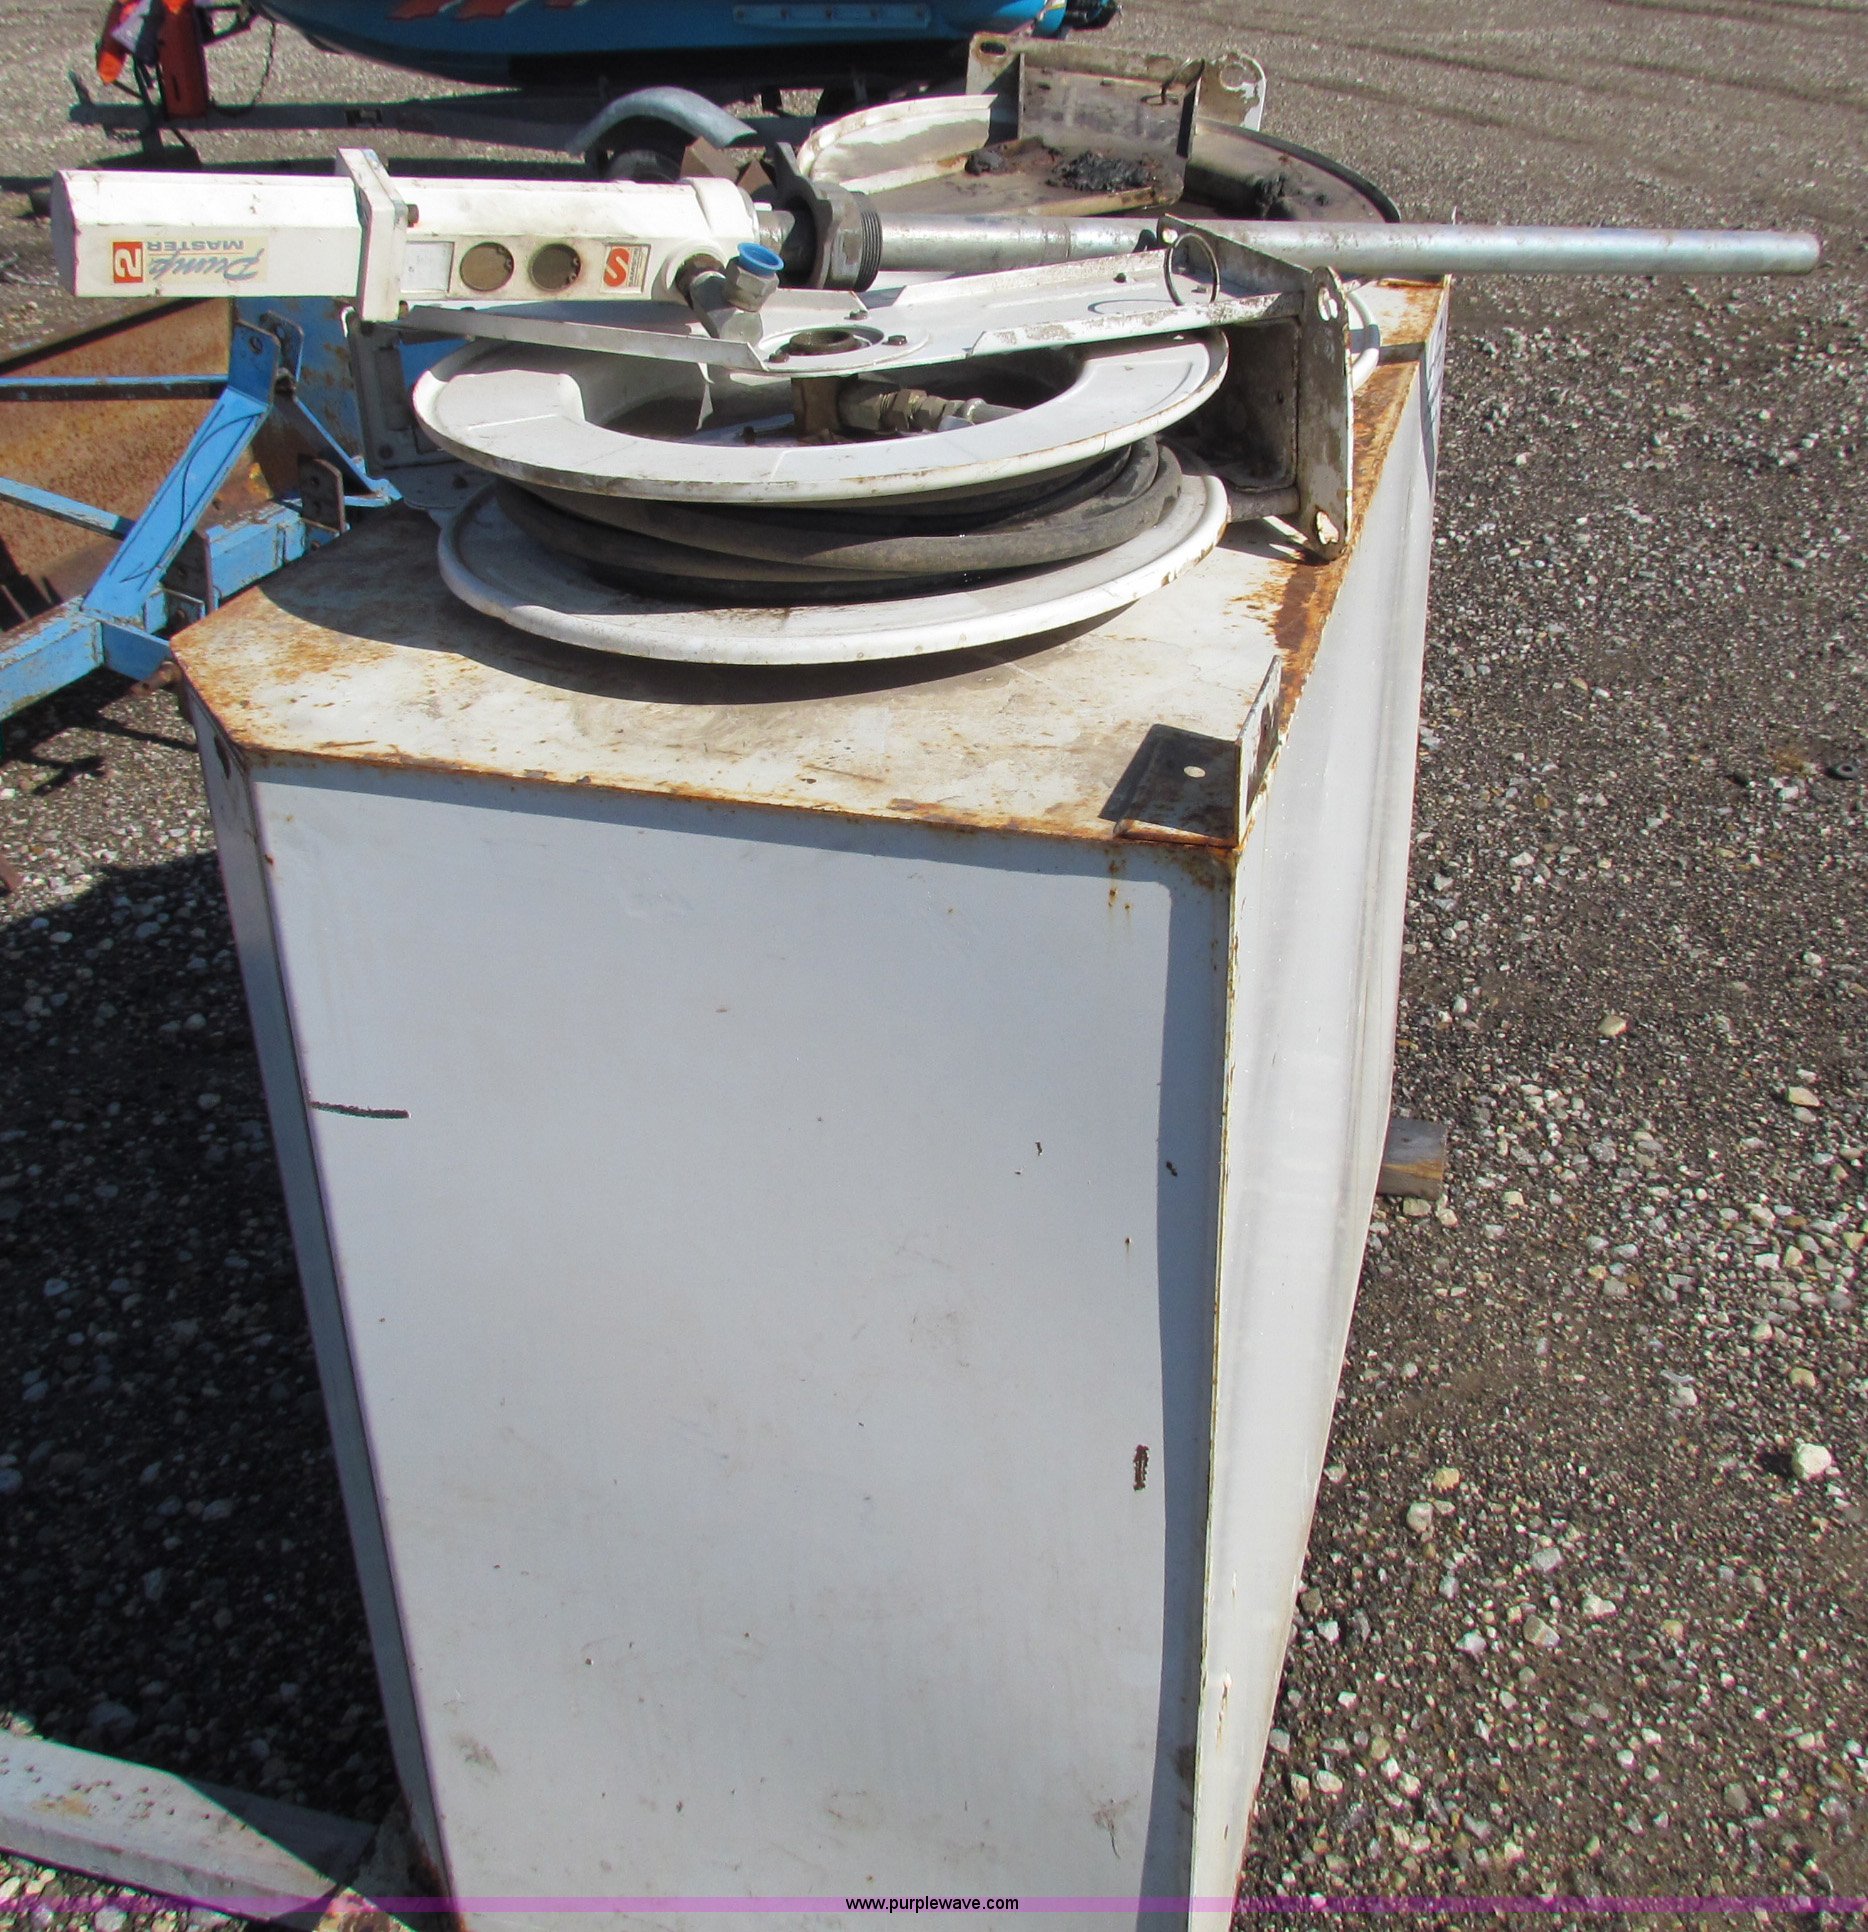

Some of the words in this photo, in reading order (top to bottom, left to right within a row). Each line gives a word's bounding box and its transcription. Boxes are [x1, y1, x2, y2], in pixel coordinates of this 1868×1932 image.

[147, 240, 244, 251] MASTER
[114, 247, 142, 278] 2
[149, 248, 265, 281] Pump
